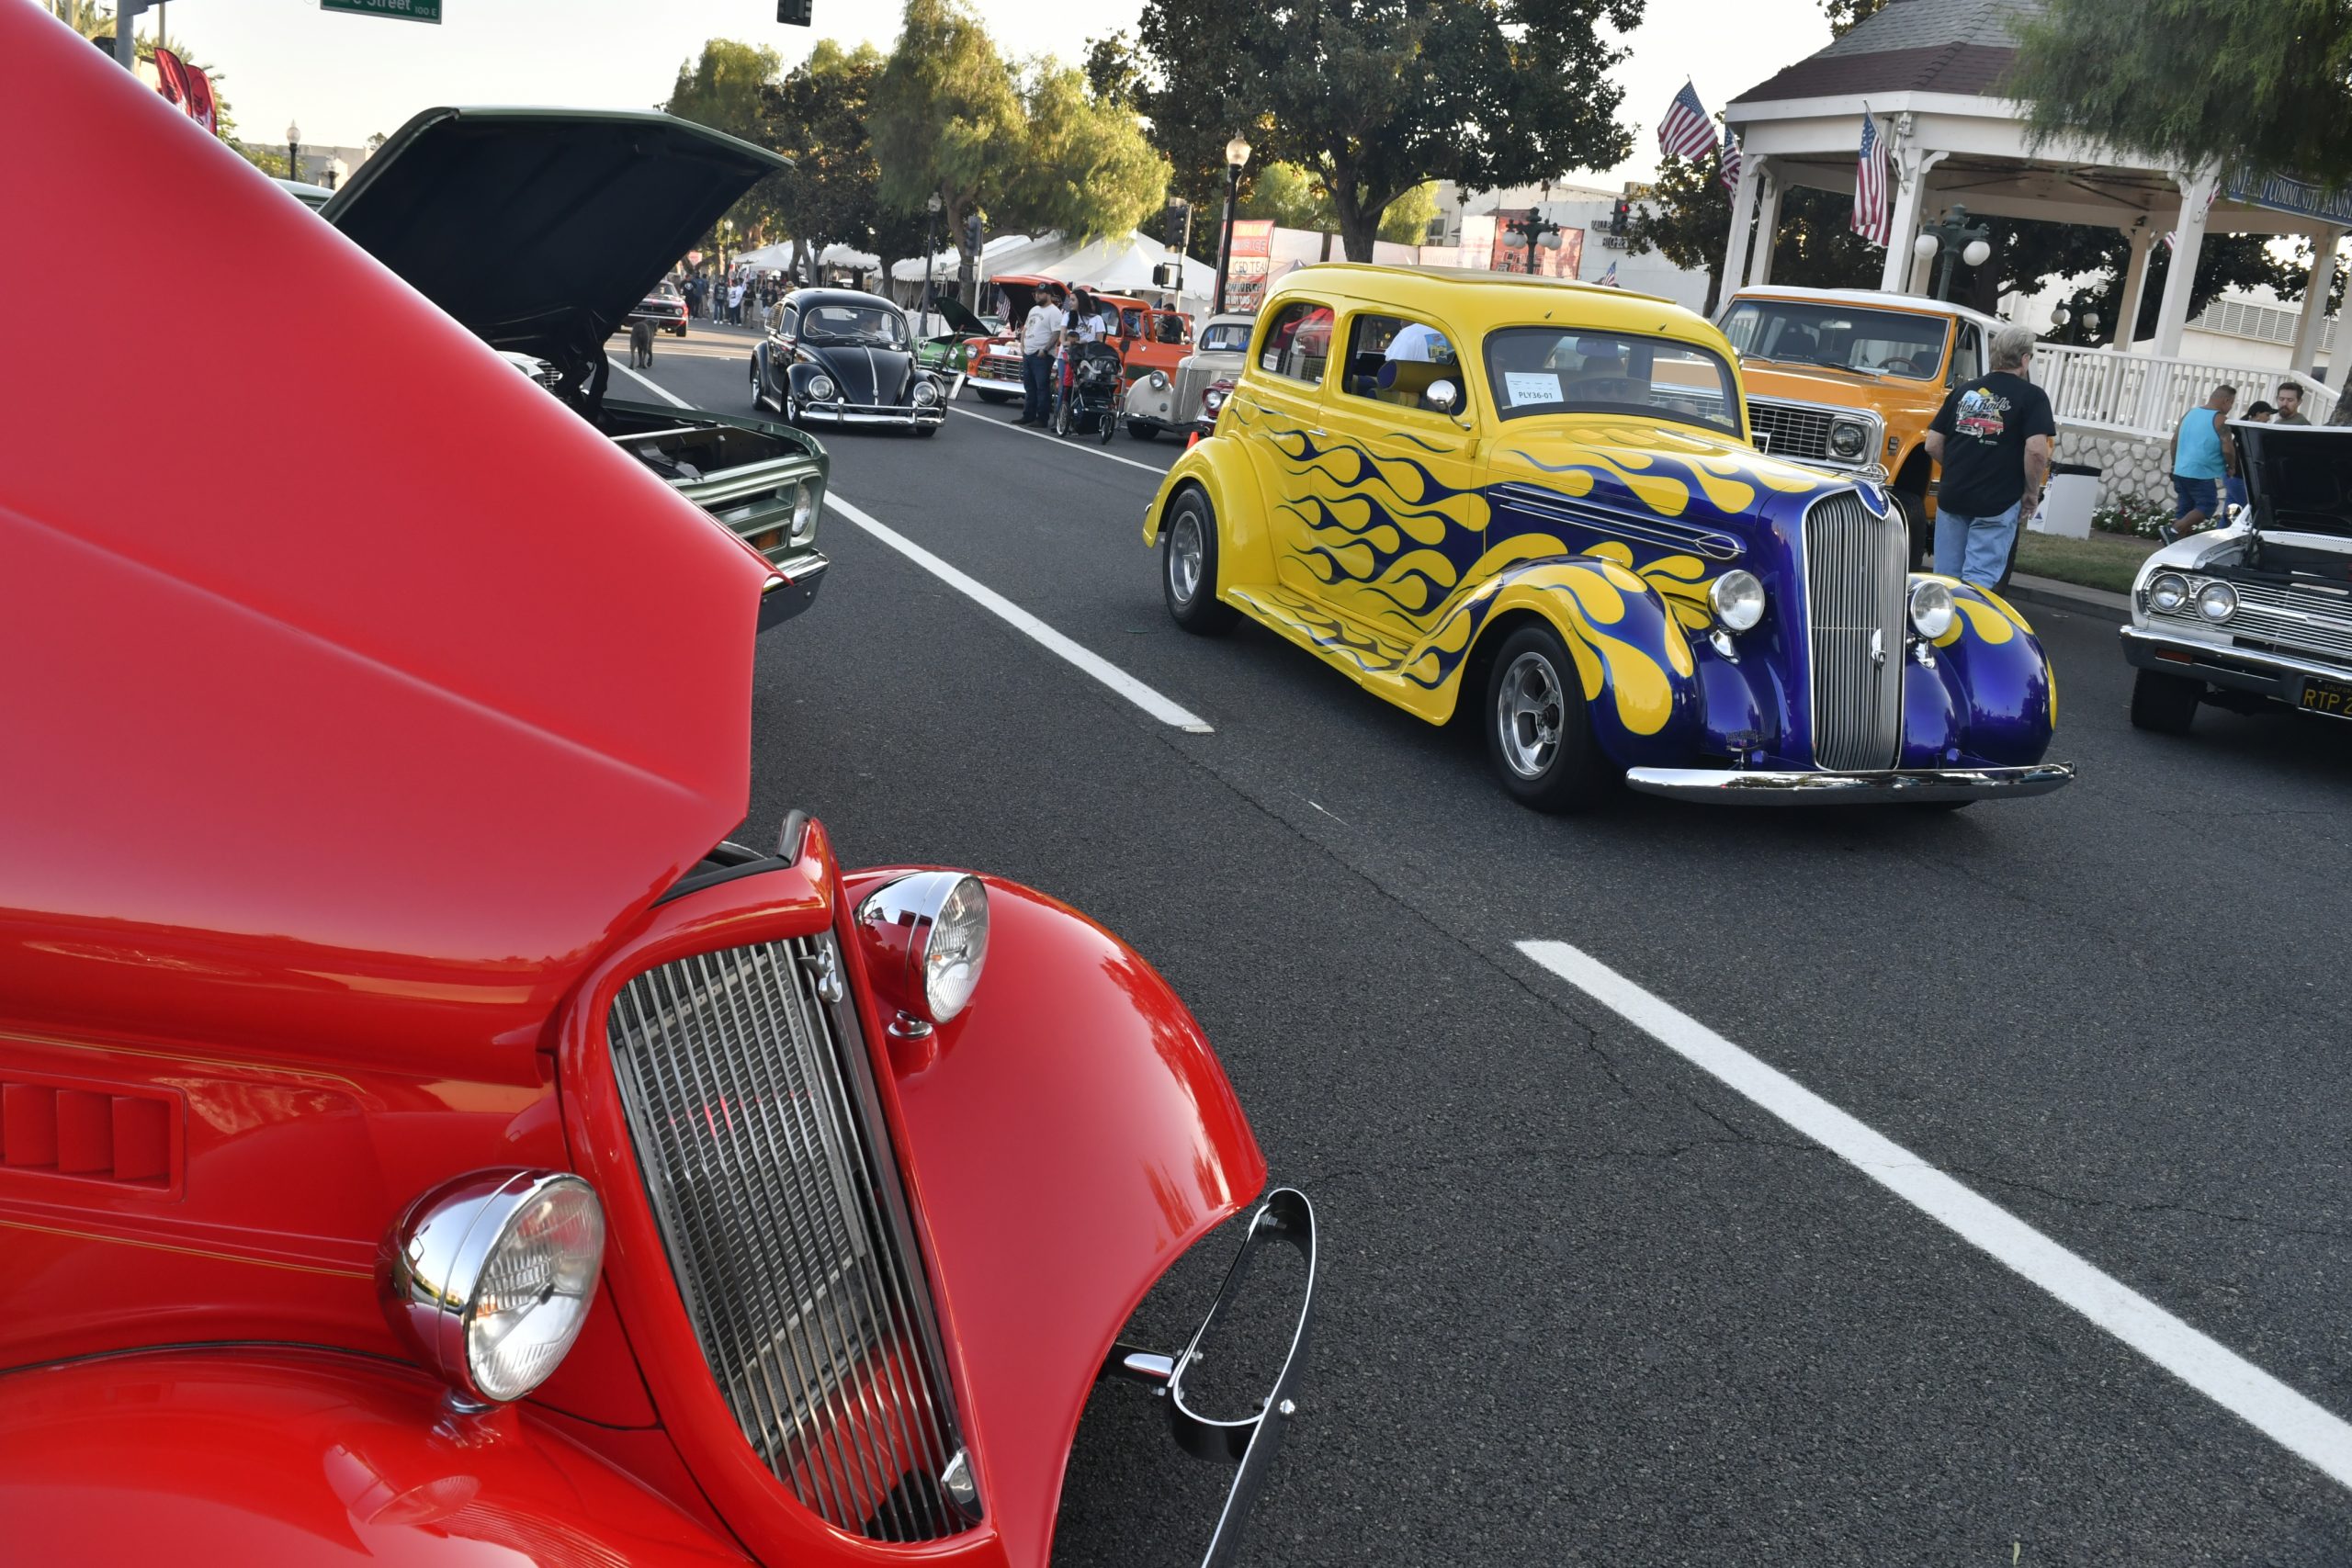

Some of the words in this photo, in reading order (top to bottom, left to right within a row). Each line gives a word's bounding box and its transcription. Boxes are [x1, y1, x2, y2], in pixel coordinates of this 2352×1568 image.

[367, 0, 411, 10] Street
[413, 6, 430, 16] 100
[431, 7, 437, 17] E
[2269, 176, 2323, 209] COMMUNITY
[1956, 399, 1978, 414] Hot
[1977, 397, 2011, 412] Rods
[2303, 689, 2341, 710] RTP
